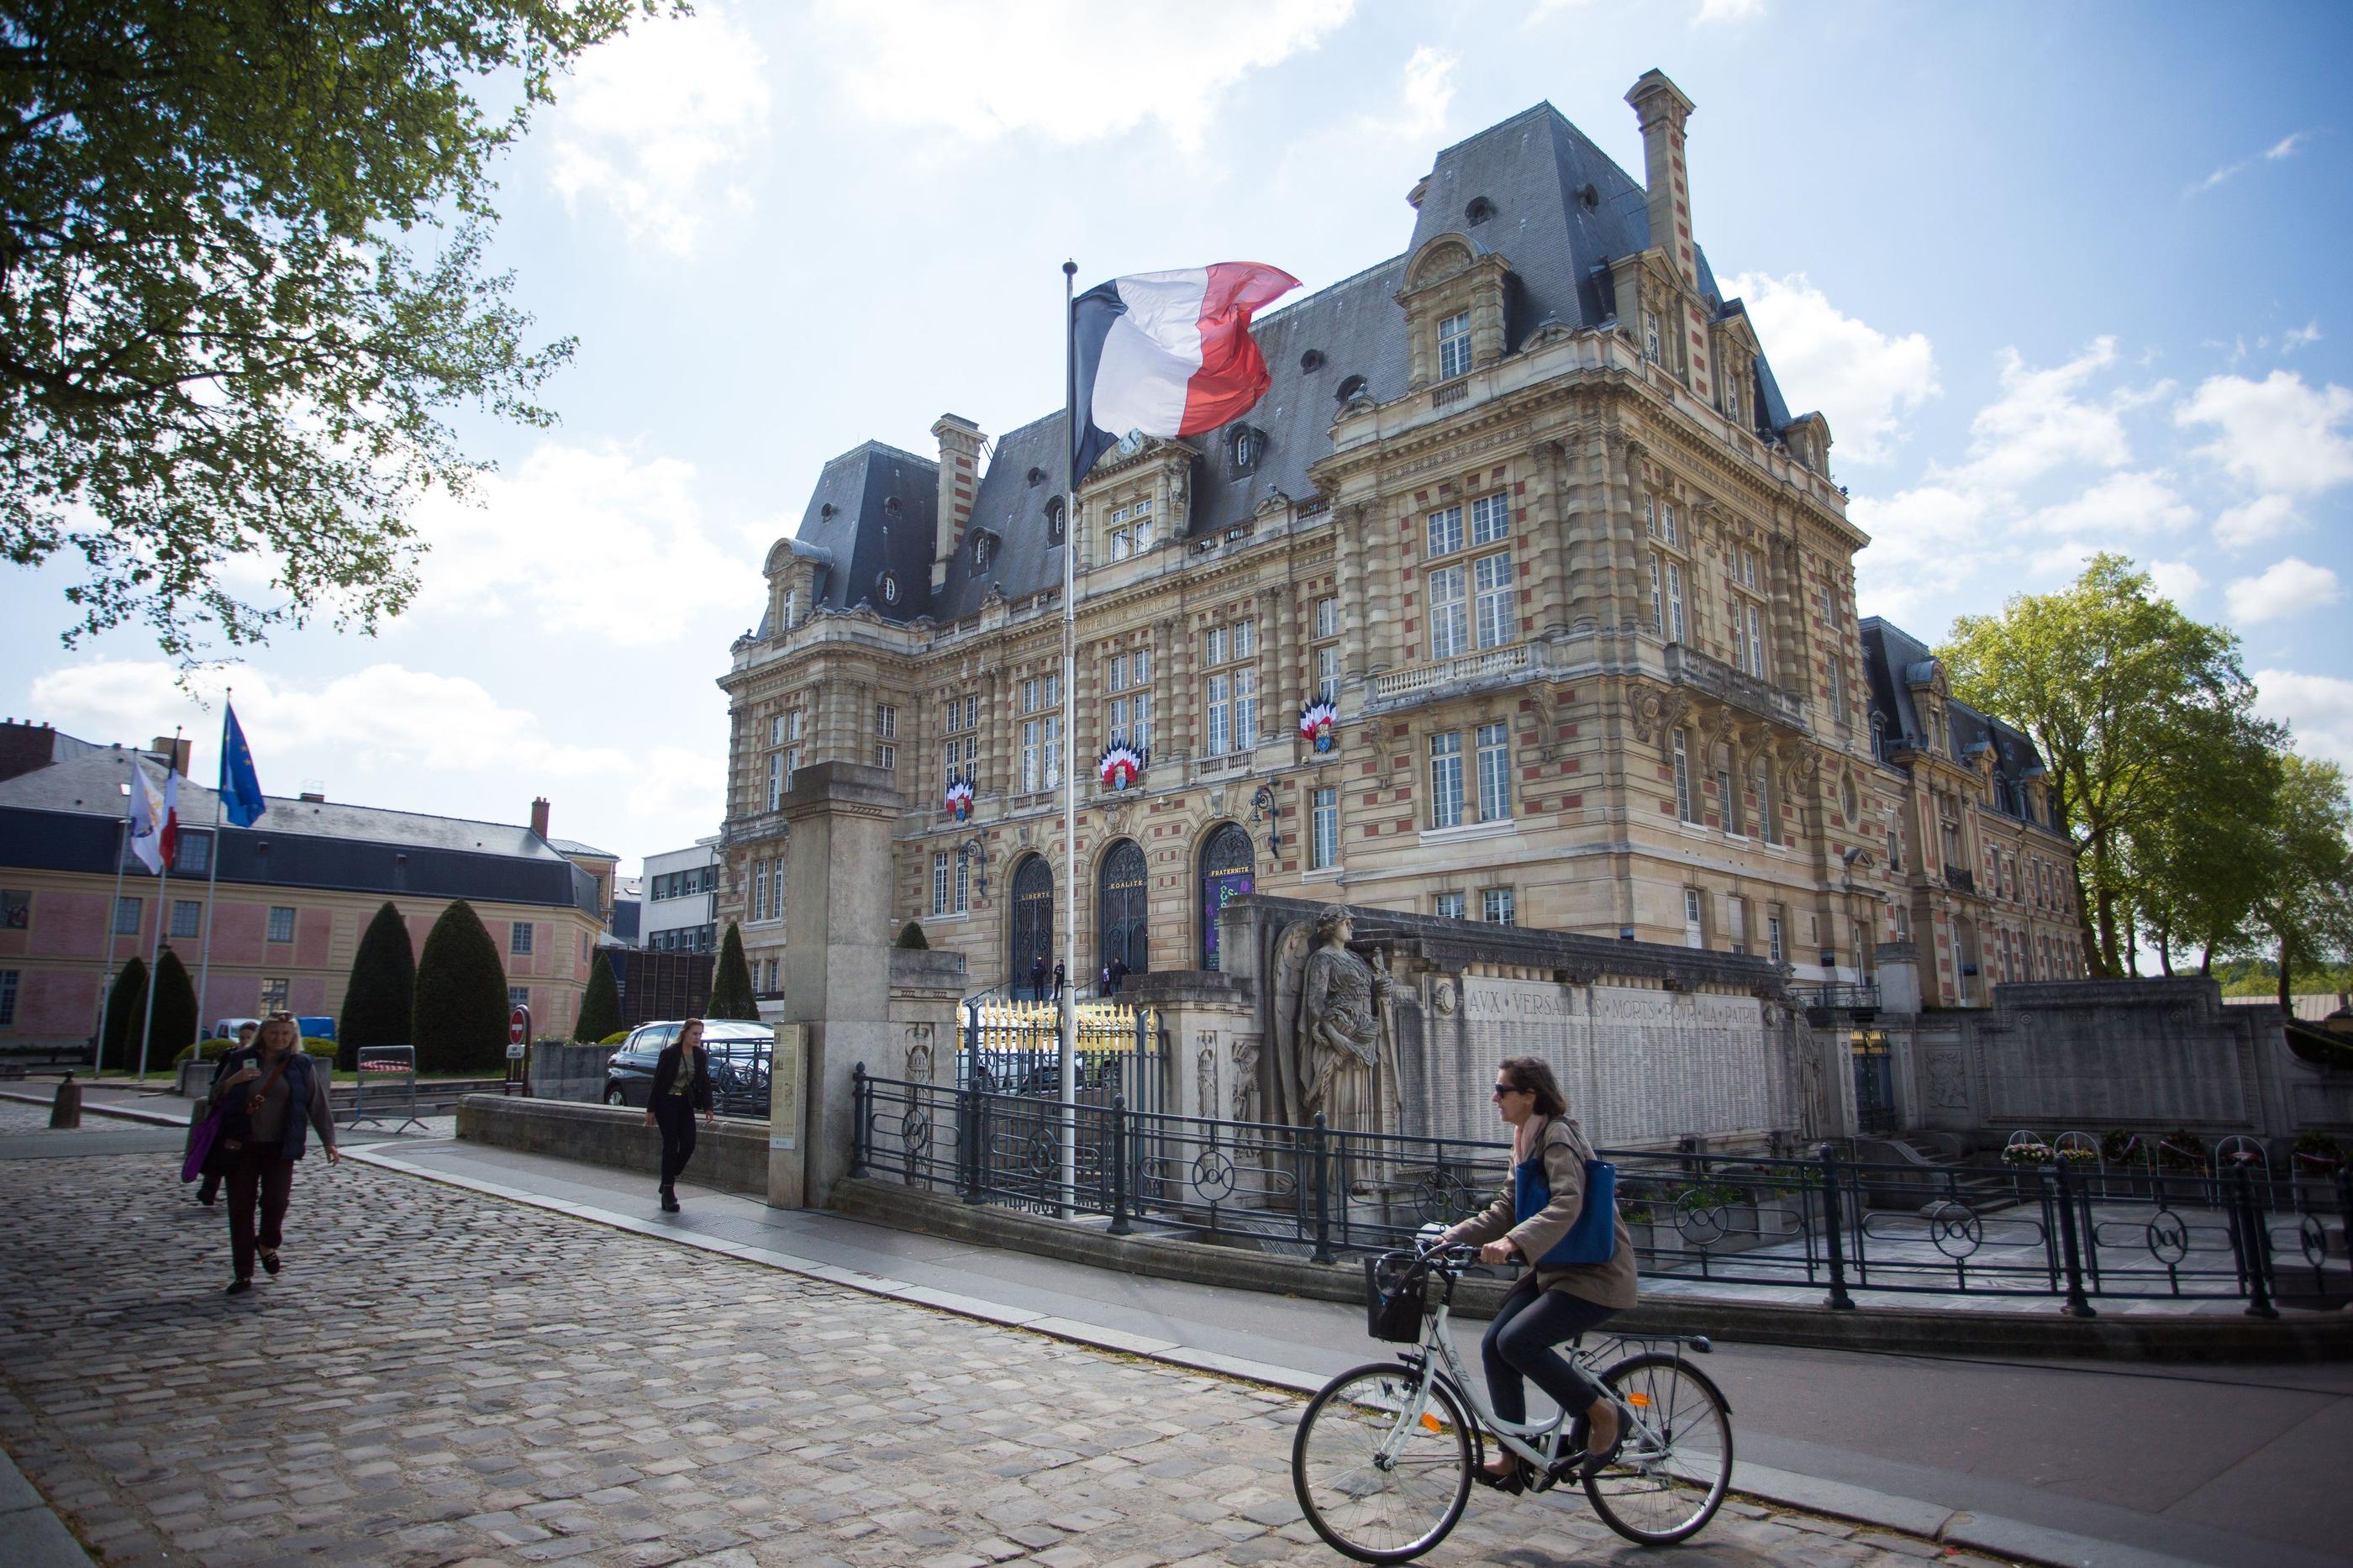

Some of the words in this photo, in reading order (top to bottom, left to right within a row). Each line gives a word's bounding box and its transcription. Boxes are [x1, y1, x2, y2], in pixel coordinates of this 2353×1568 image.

[1134, 599, 1166, 616] VILLE
[1211, 866, 1250, 876] FRATERNITE
[1021, 892, 1050, 901] LIBERTE
[1469, 990, 1500, 1013] AVX
[1513, 992, 1601, 1018] VERSALLAS
[1613, 998, 1655, 1020] MORTS
[1664, 1002, 1695, 1022] POVR
[1704, 1004, 1716, 1023] LA
[1725, 1005, 1759, 1024] PATRIE
